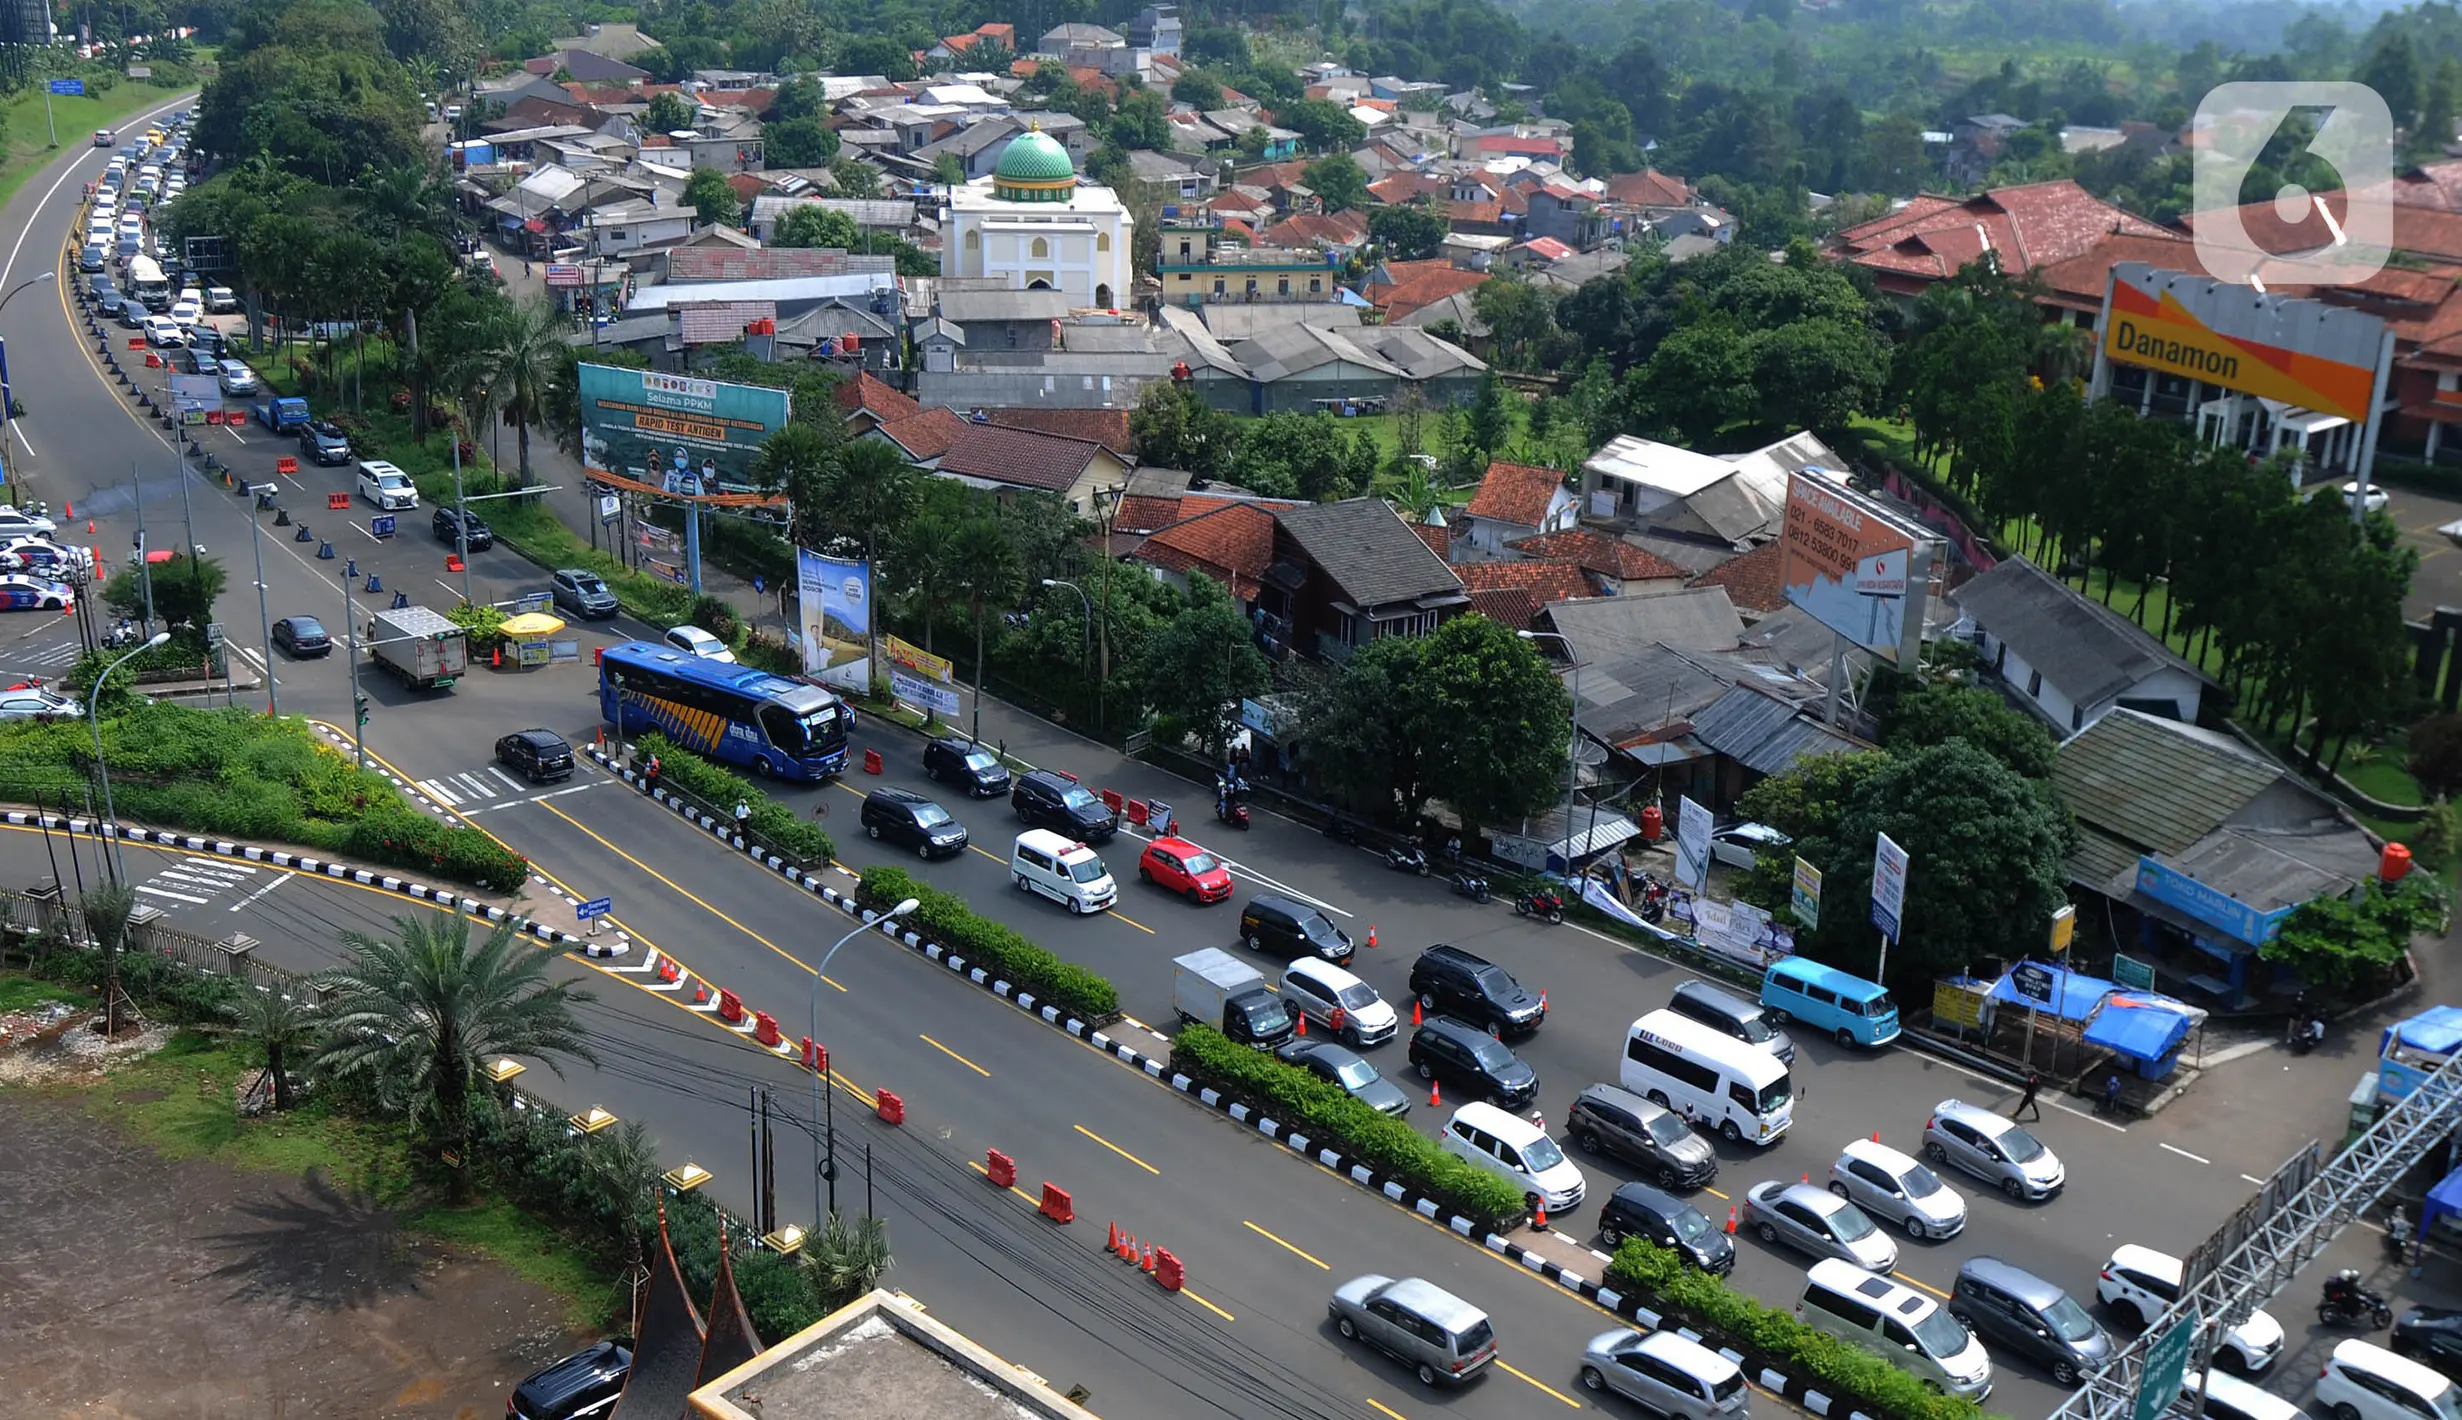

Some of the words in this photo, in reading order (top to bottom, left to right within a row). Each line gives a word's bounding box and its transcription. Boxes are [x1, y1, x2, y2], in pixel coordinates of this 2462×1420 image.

[2117, 320, 2238, 379] Danamon
[647, 392, 681, 406] Selama
[683, 398, 712, 411] PPKM
[639, 416, 664, 427] RAPID
[666, 420, 685, 431] TEST
[687, 423, 722, 438] ANTIGEN
[1792, 480, 1819, 508] SPACE
[1818, 494, 1863, 533] AVAILABLE
[1788, 524, 1810, 547] 0812
[1791, 504, 1805, 523] 021
[1837, 530, 1859, 553] 7017
[2164, 873, 2195, 898] TOKO
